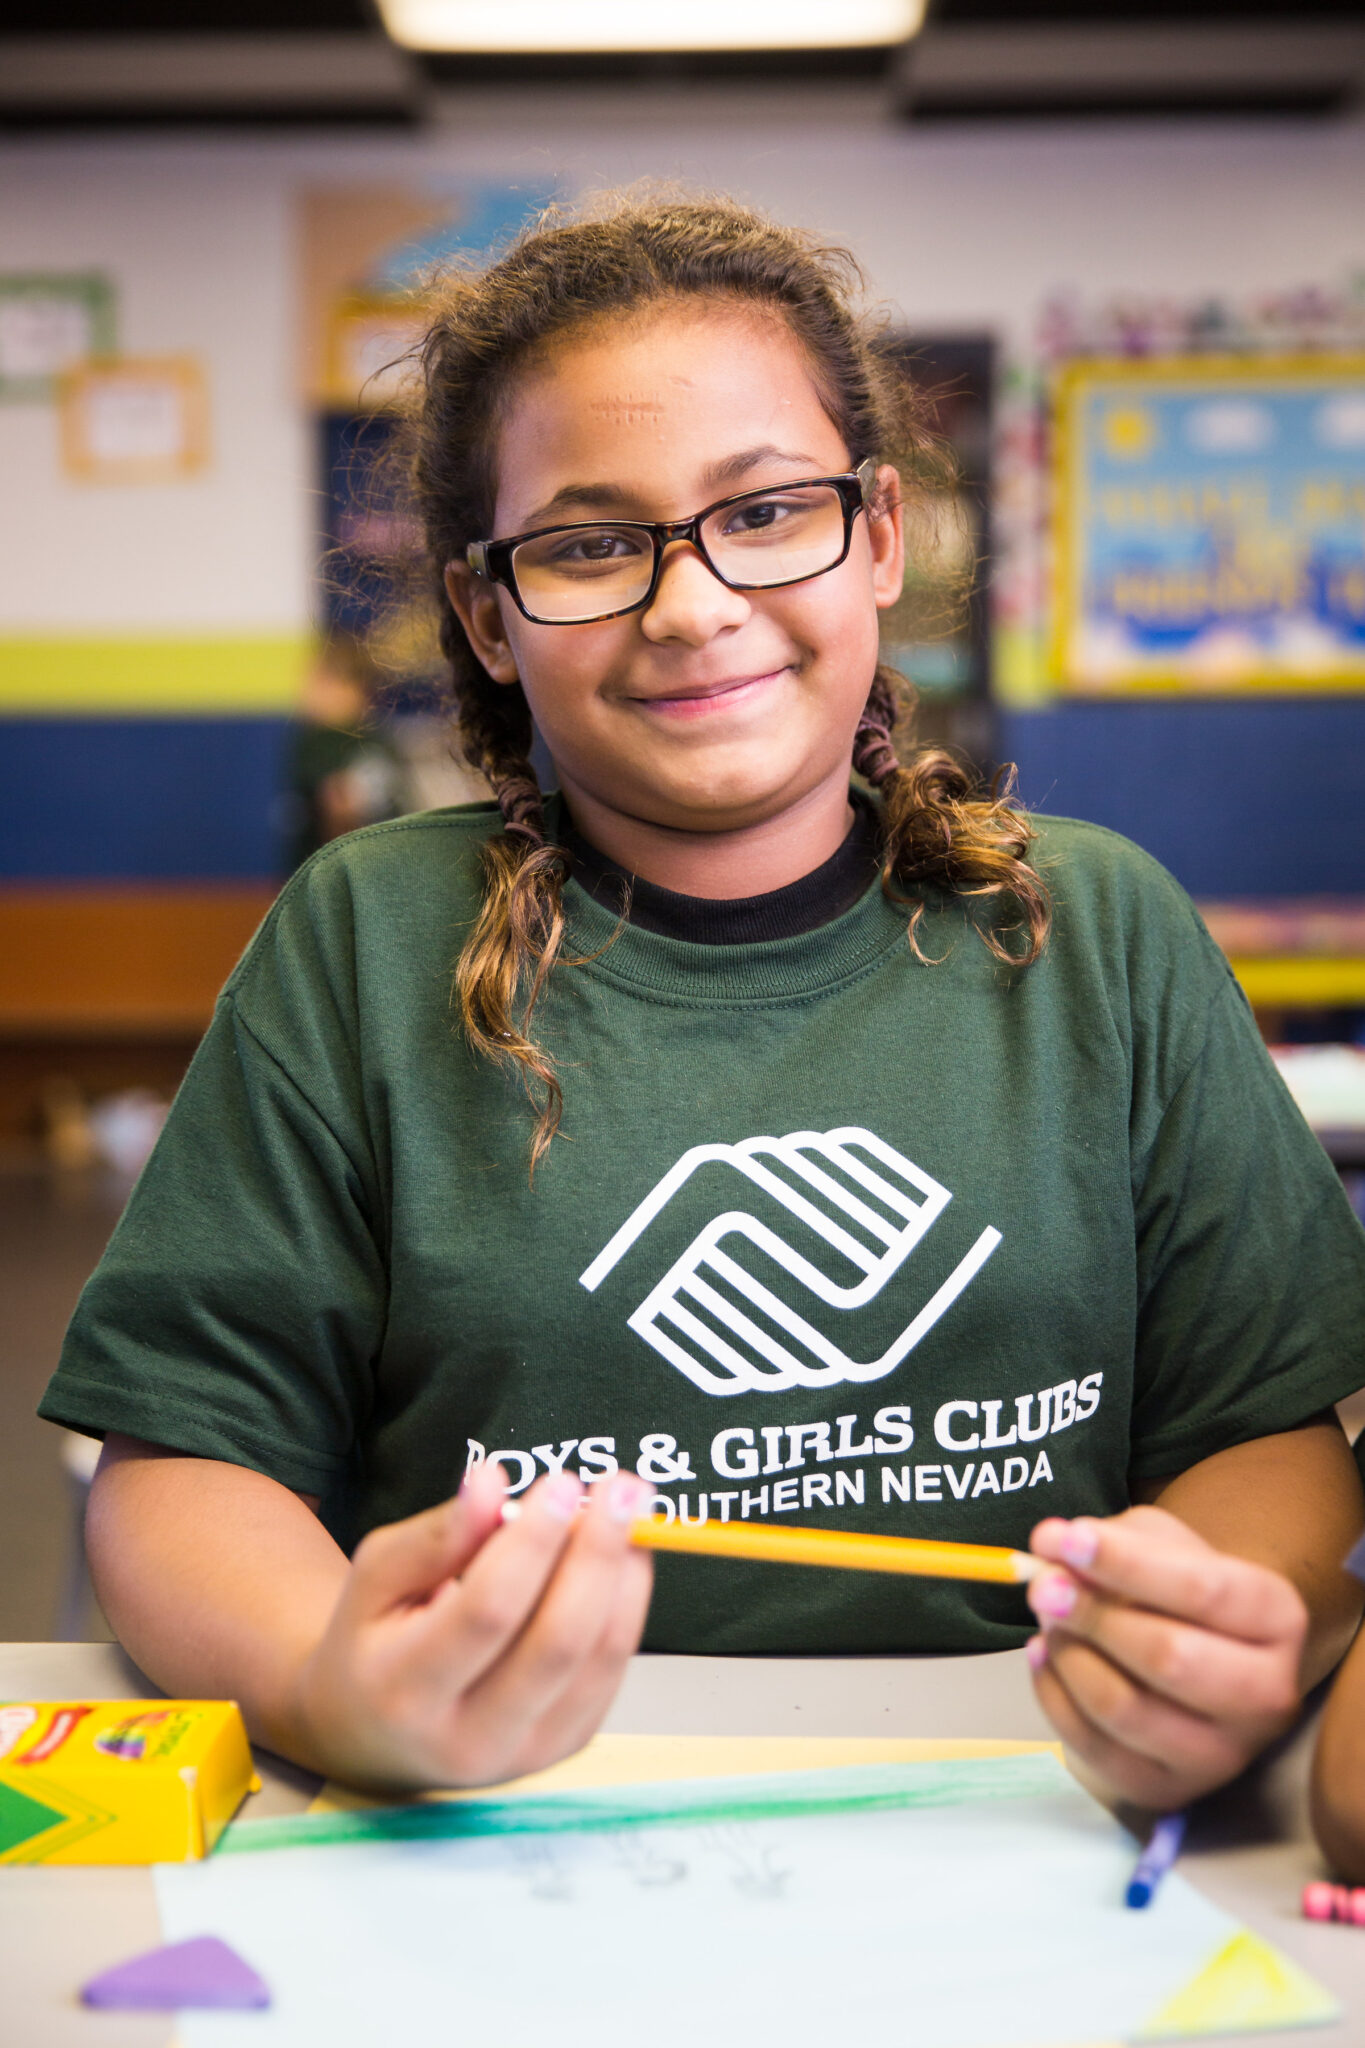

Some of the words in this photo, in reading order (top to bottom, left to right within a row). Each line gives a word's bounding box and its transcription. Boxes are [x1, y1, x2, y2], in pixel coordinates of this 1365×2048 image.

[636, 1433, 697, 1483] &
[711, 1405, 914, 1480] GIRLS
[934, 1371, 1104, 1451] CLUBS
[649, 1469, 865, 1528] OUTHERN
[881, 1450, 1054, 1503] NEVADA
